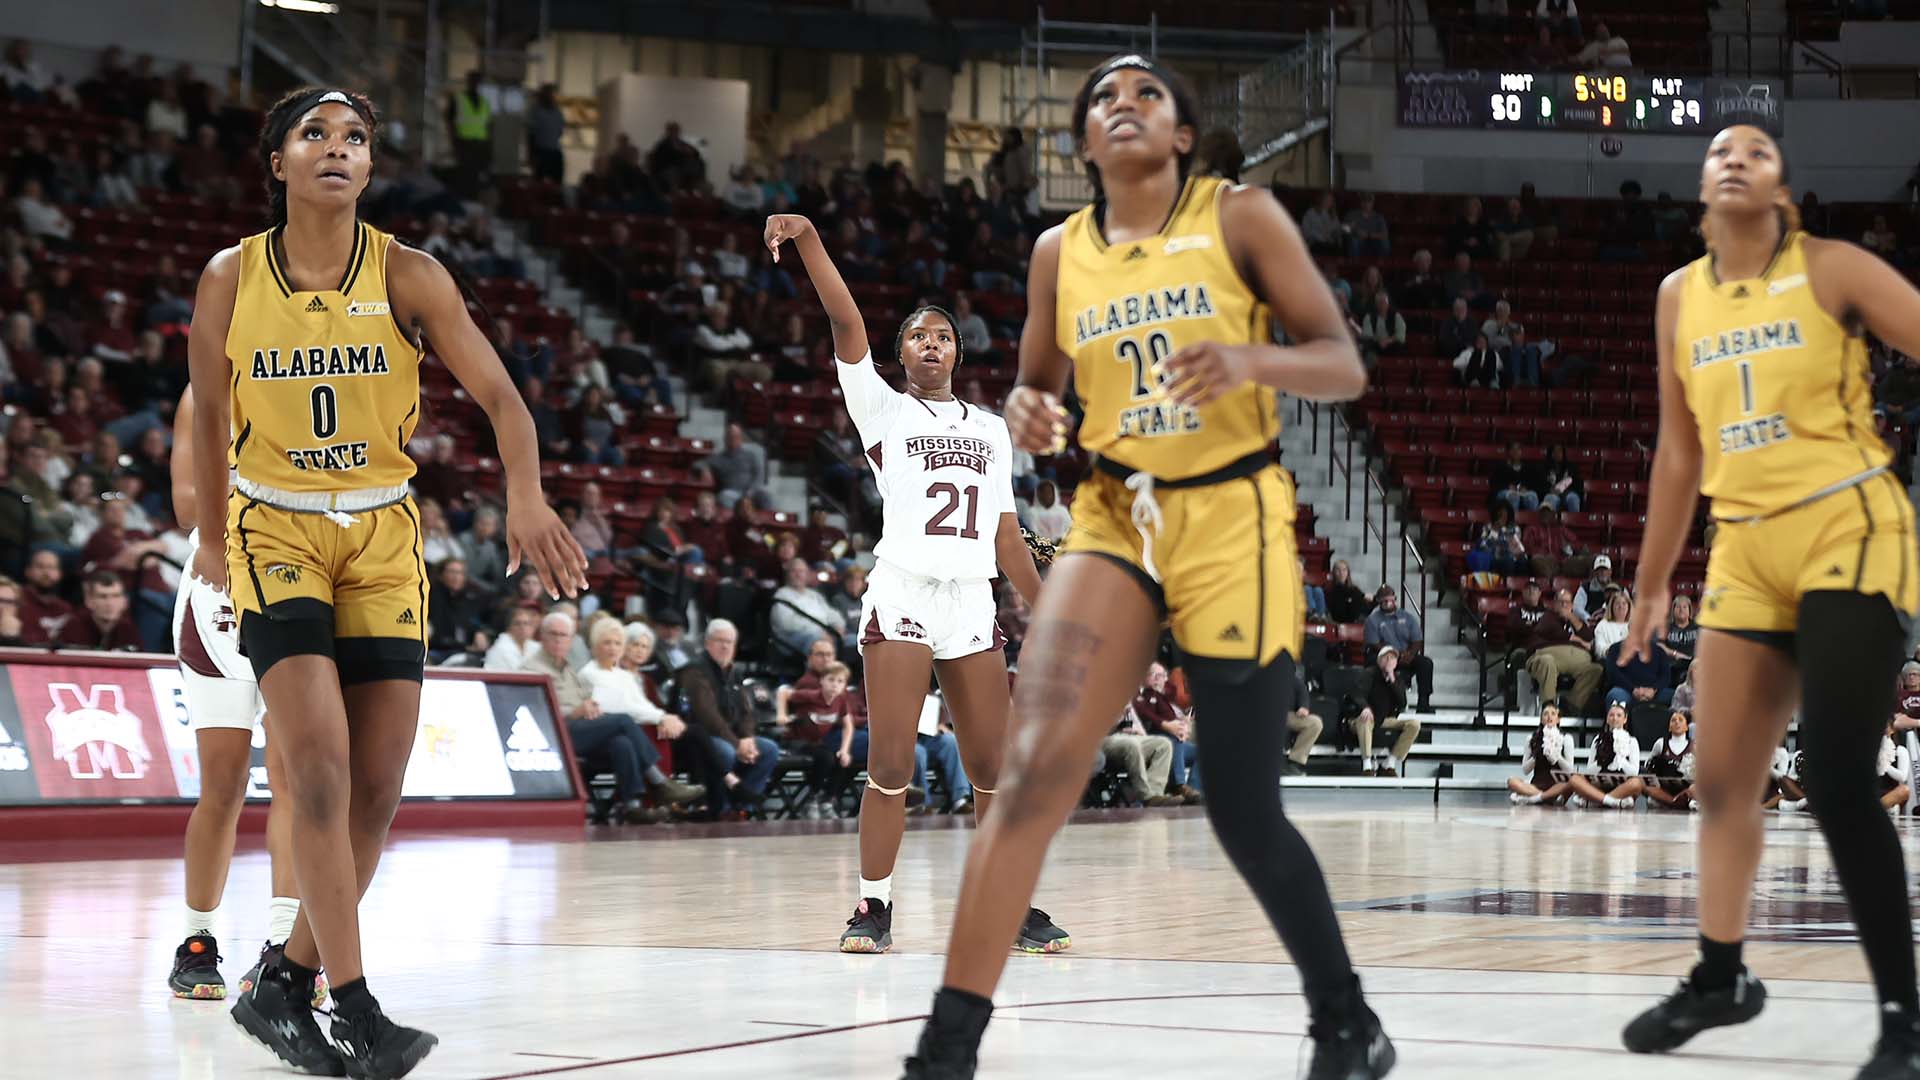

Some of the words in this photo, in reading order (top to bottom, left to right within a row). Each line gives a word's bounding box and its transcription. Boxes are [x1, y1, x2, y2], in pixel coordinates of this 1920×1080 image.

[1574, 74, 1627, 103] 5:48
[1491, 94, 1521, 121] 50
[1564, 109, 1596, 121] PERIOD
[1671, 99, 1701, 126] 29
[1075, 286, 1214, 344] ALABAMA
[1691, 320, 1804, 368] ALABAMA
[251, 346, 389, 380] ALABAMA
[1739, 360, 1753, 415] 1
[309, 384, 337, 440] 0
[1719, 414, 1791, 455] STATE
[286, 442, 368, 472] STATE
[934, 452, 979, 471] STATE
[925, 482, 979, 540] 21
[1554, 772, 1656, 787] DFENE
